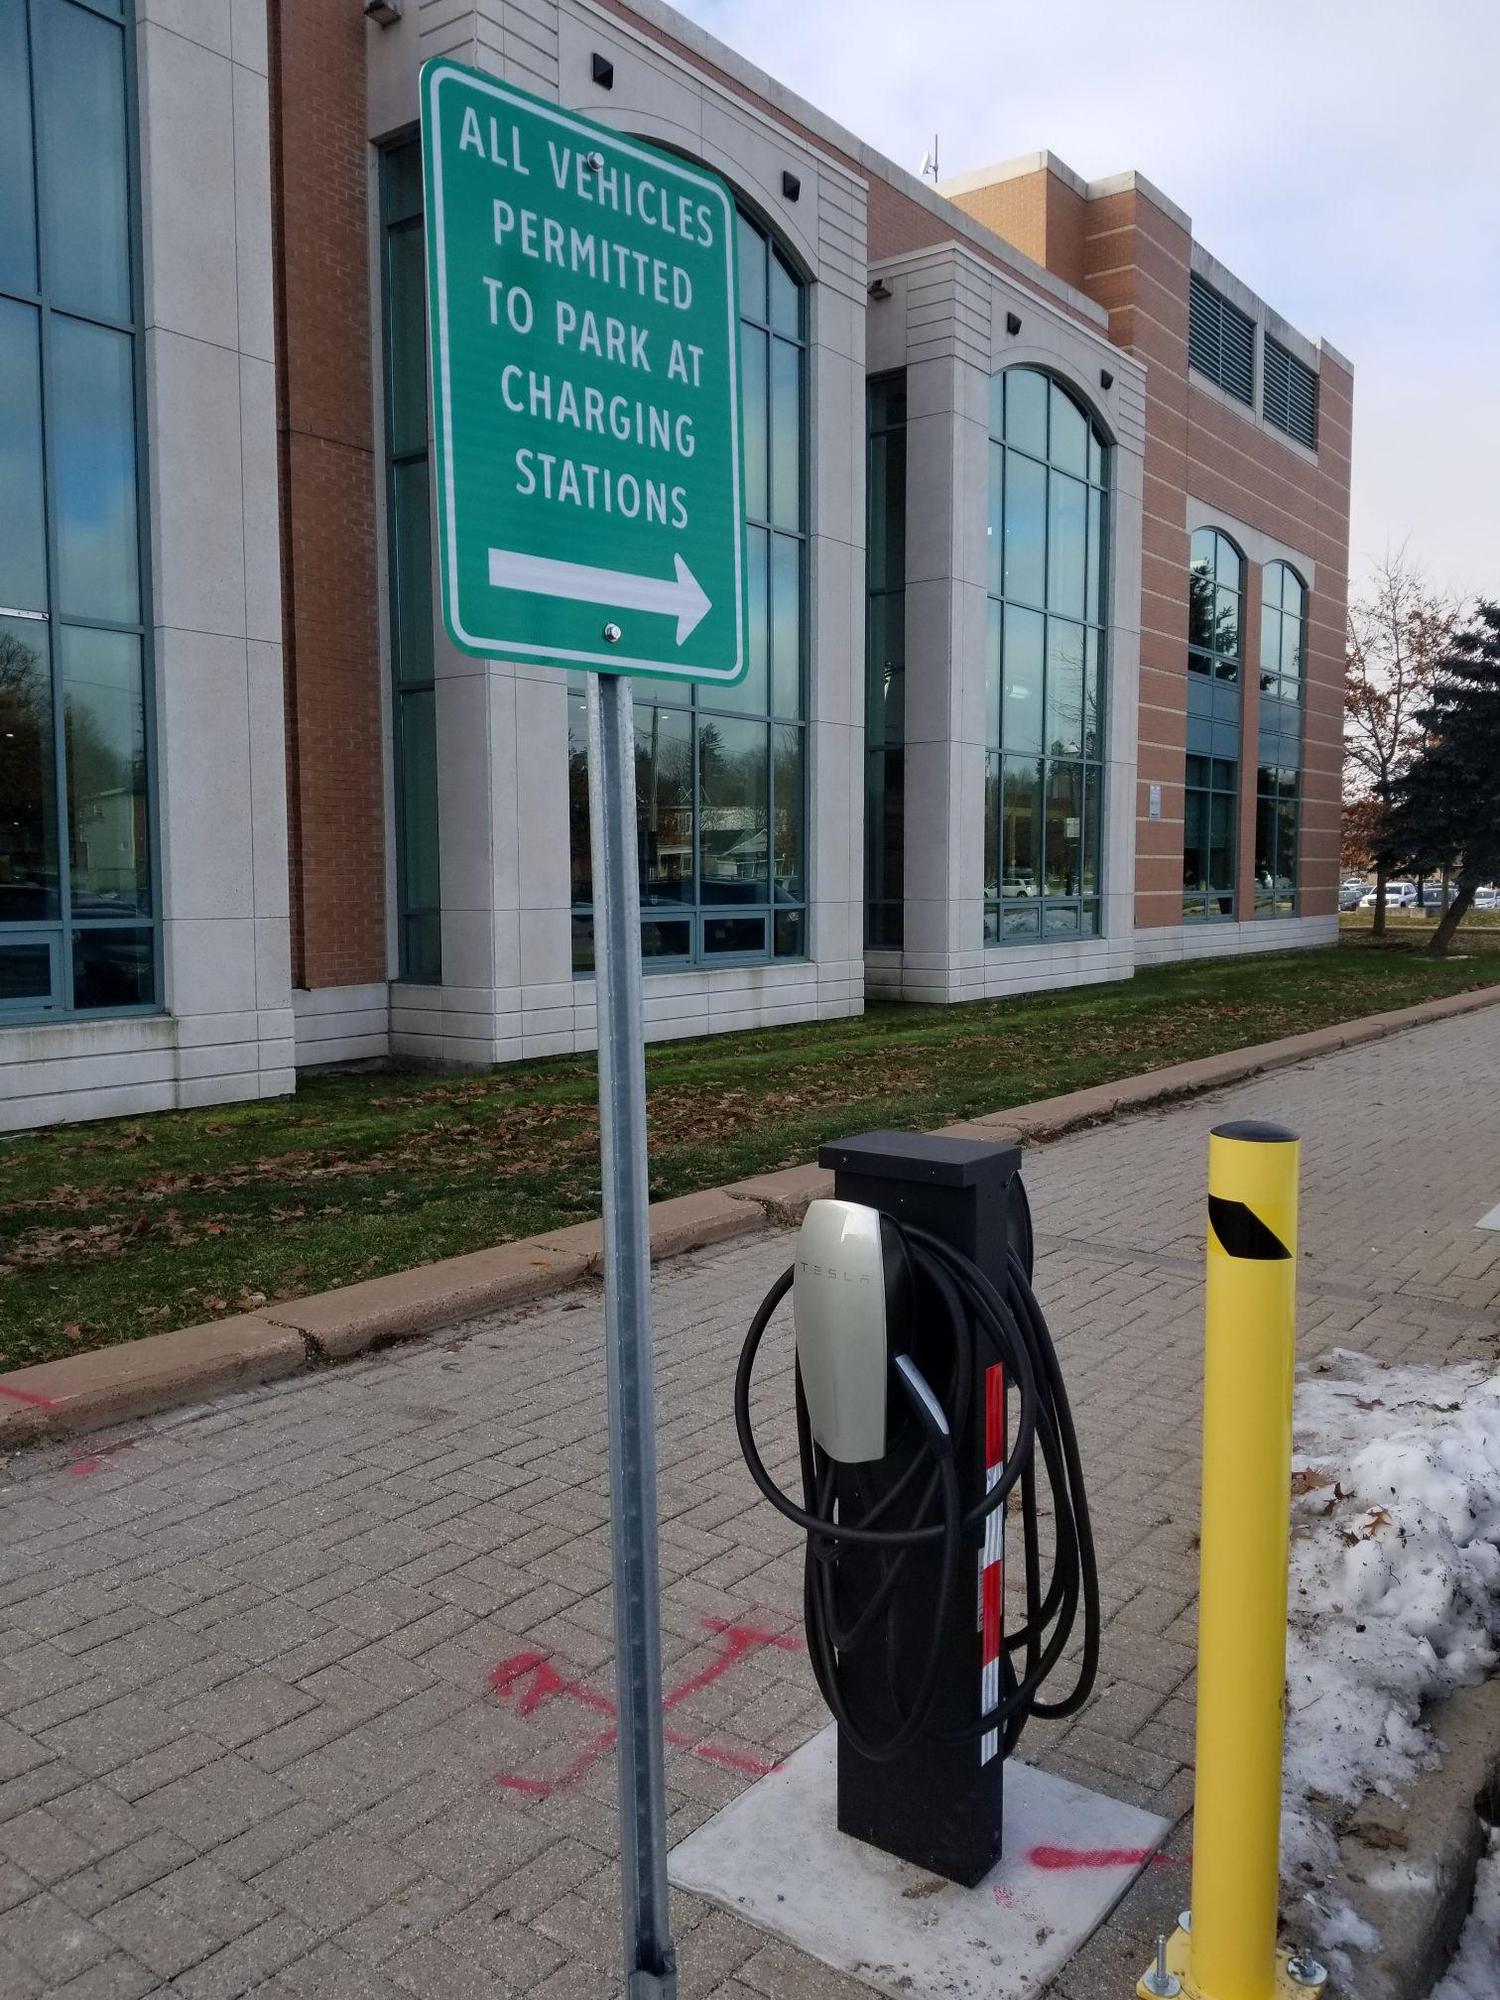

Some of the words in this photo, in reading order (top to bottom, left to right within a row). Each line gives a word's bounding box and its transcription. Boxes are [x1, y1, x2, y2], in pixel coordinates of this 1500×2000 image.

[459, 107, 529, 176] ALL
[548, 140, 713, 248] VEHICLES
[493, 198, 693, 310] PERMITTED
[483, 276, 533, 334] TO
[556, 300, 651, 372] PARK
[667, 339, 704, 387] AT
[501, 364, 696, 458] CHARGING
[515, 449, 688, 529] STATIONS
[800, 1262, 871, 1284] TESLA
